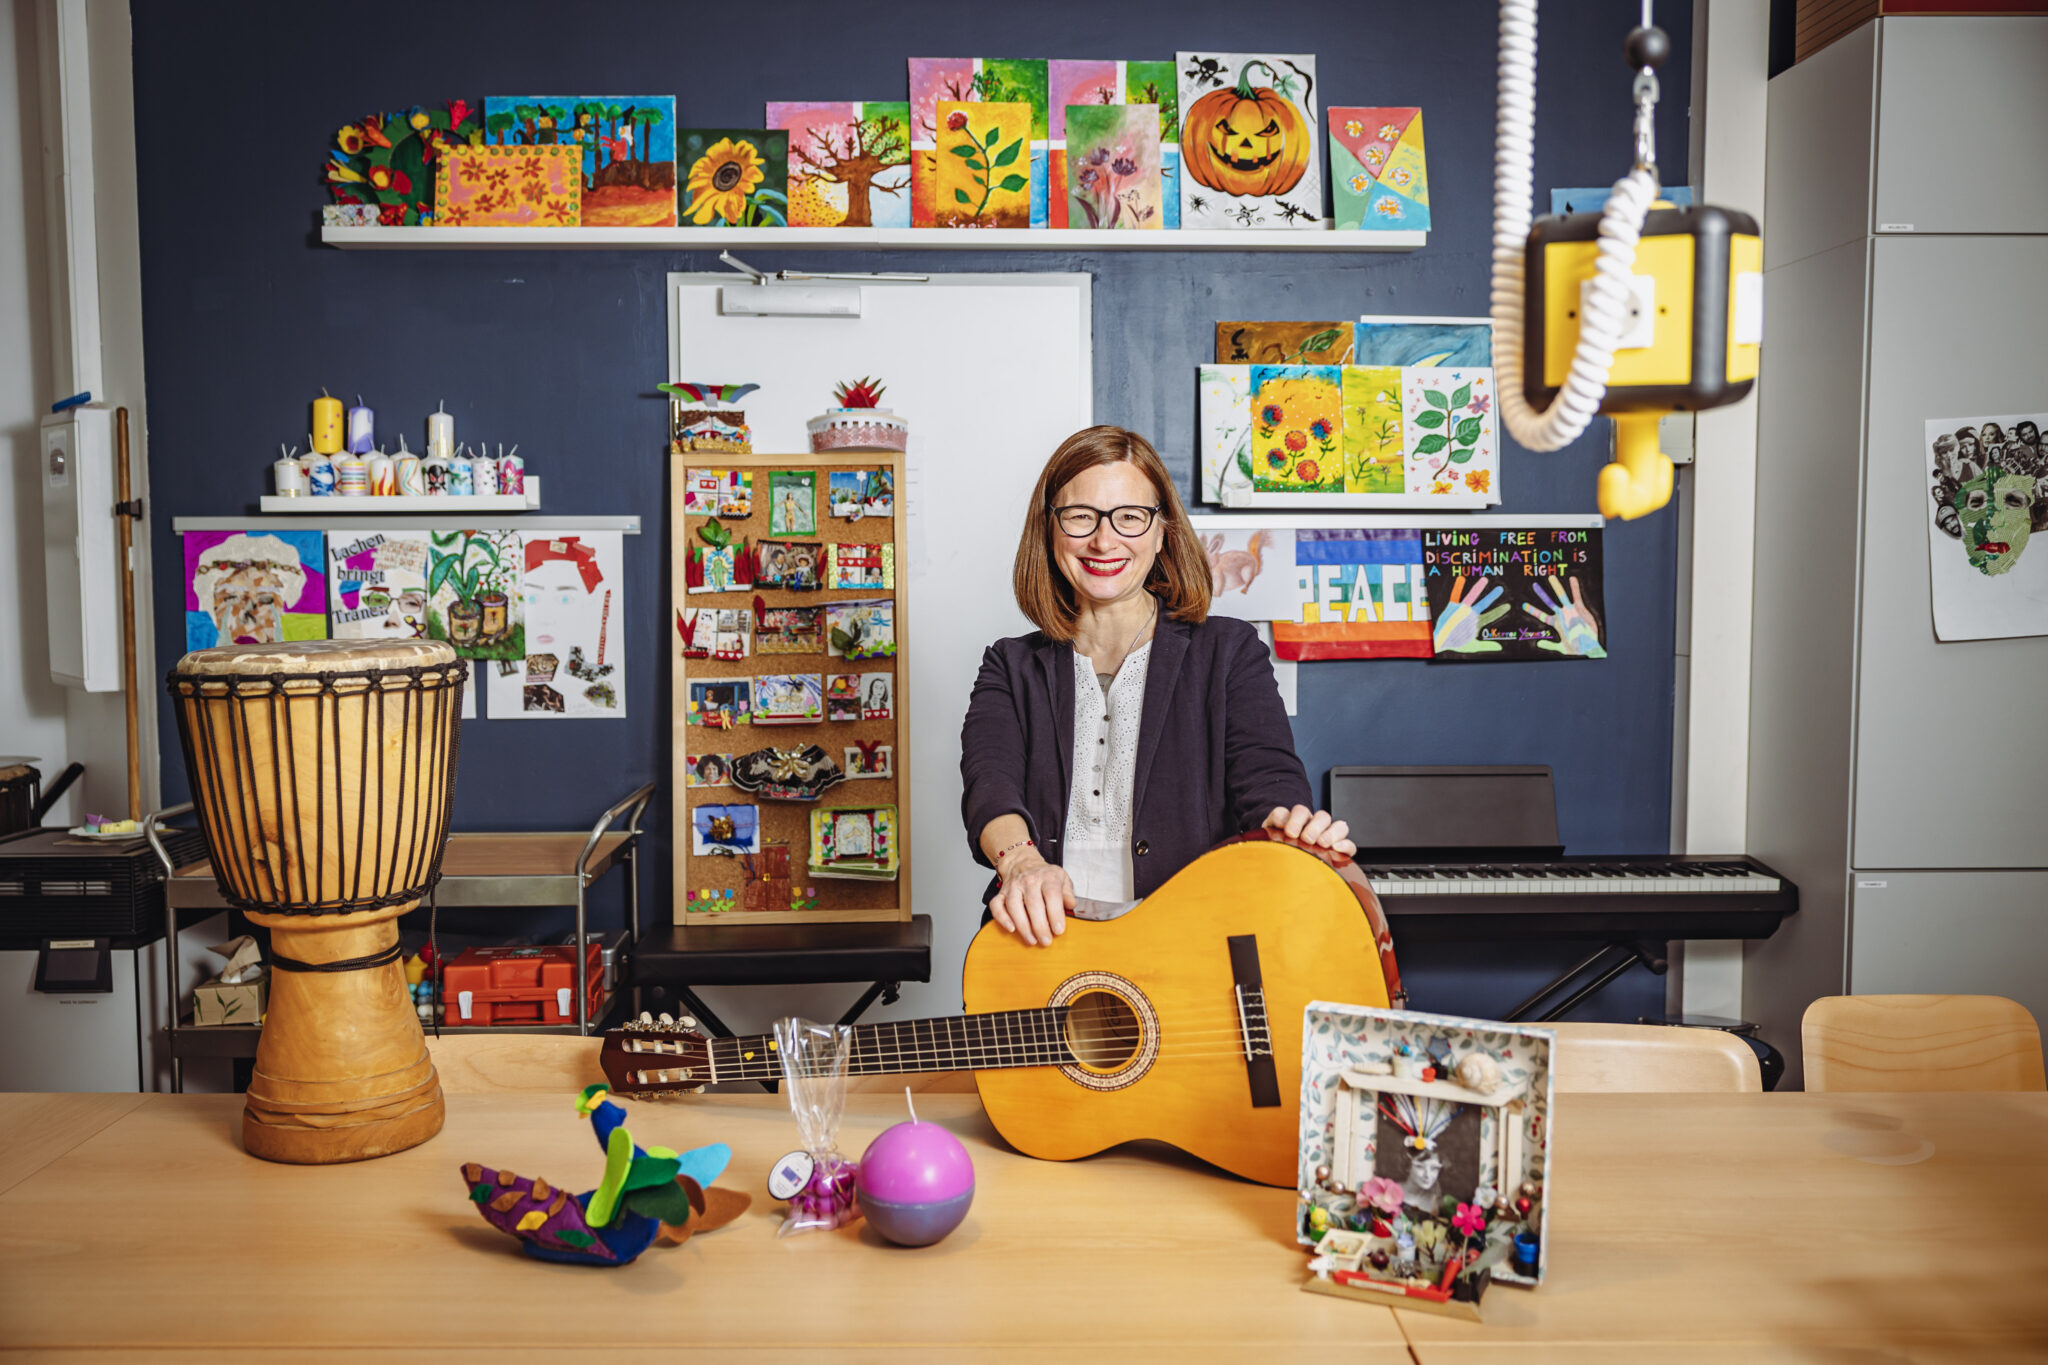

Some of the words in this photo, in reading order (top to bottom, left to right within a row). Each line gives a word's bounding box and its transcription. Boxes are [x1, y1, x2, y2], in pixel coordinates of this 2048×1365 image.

[331, 533, 386, 562] Lachen
[1500, 531, 1536, 546] FREE
[1551, 530, 1587, 544] FROM
[337, 565, 385, 585] bringt
[1428, 565, 1441, 577] A
[1452, 564, 1504, 577] HUMAN
[1294, 564, 1431, 623] PEACE
